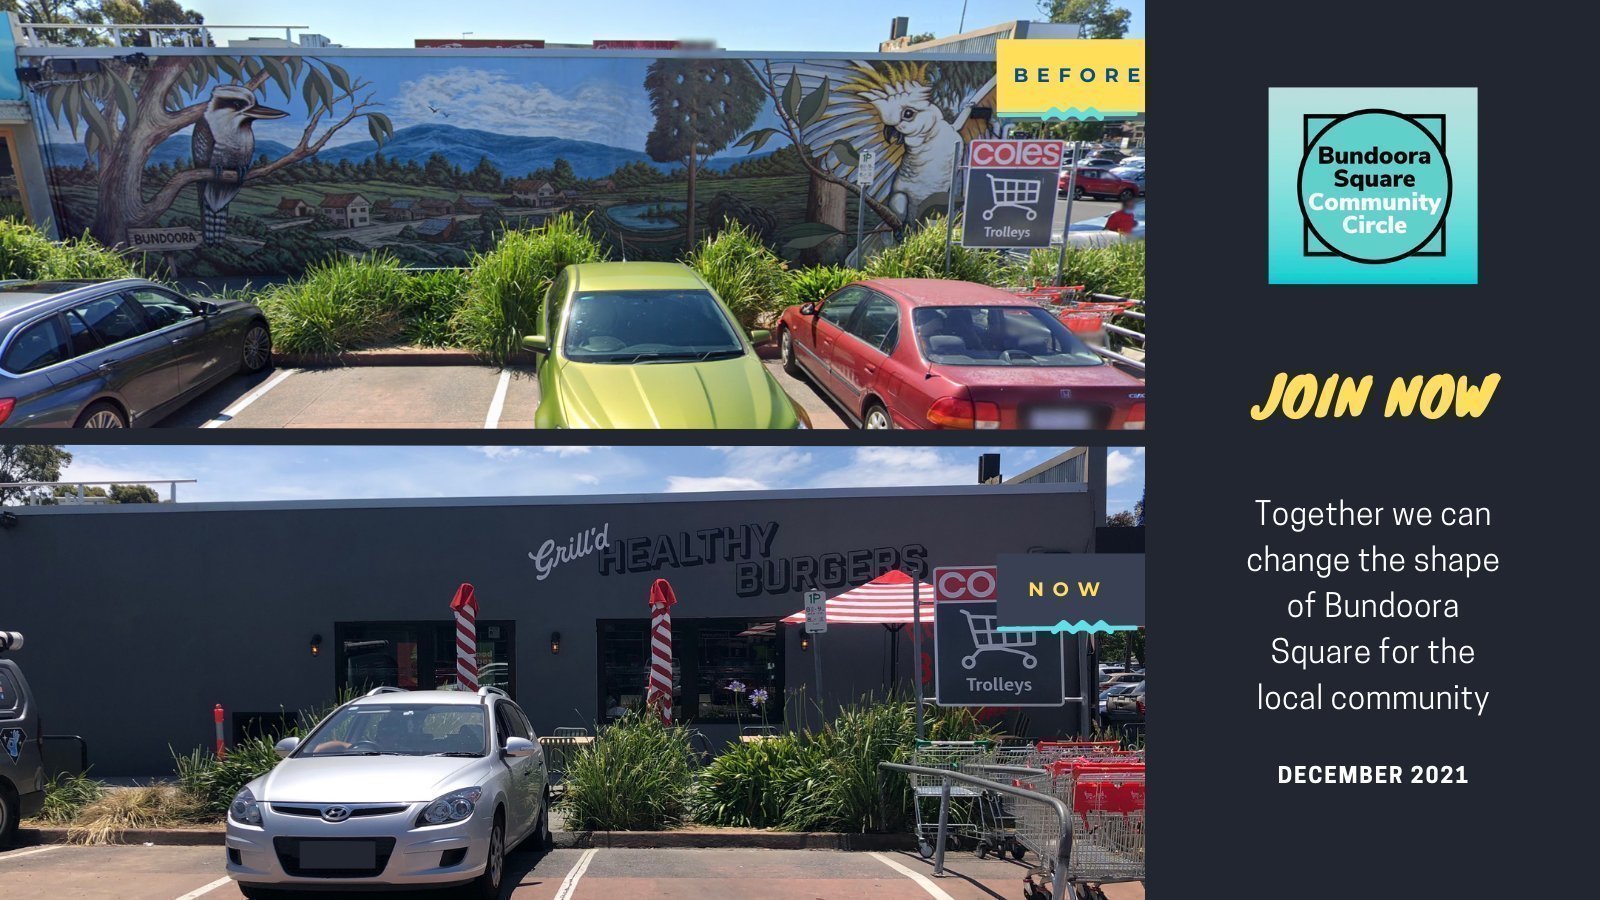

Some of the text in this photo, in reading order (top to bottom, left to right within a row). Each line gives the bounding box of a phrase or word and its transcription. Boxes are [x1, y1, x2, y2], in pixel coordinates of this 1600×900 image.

[973, 141, 1060, 165] coles
[134, 232, 197, 245] BUNDOORA
[984, 226, 1031, 240] Trolleys
[528, 523, 610, 580] Grill'd
[598, 521, 779, 576] HEALTHY
[735, 543, 929, 598] BURGERS
[809, 593, 820, 604] 1P
[966, 676, 1032, 696] Trolleys
